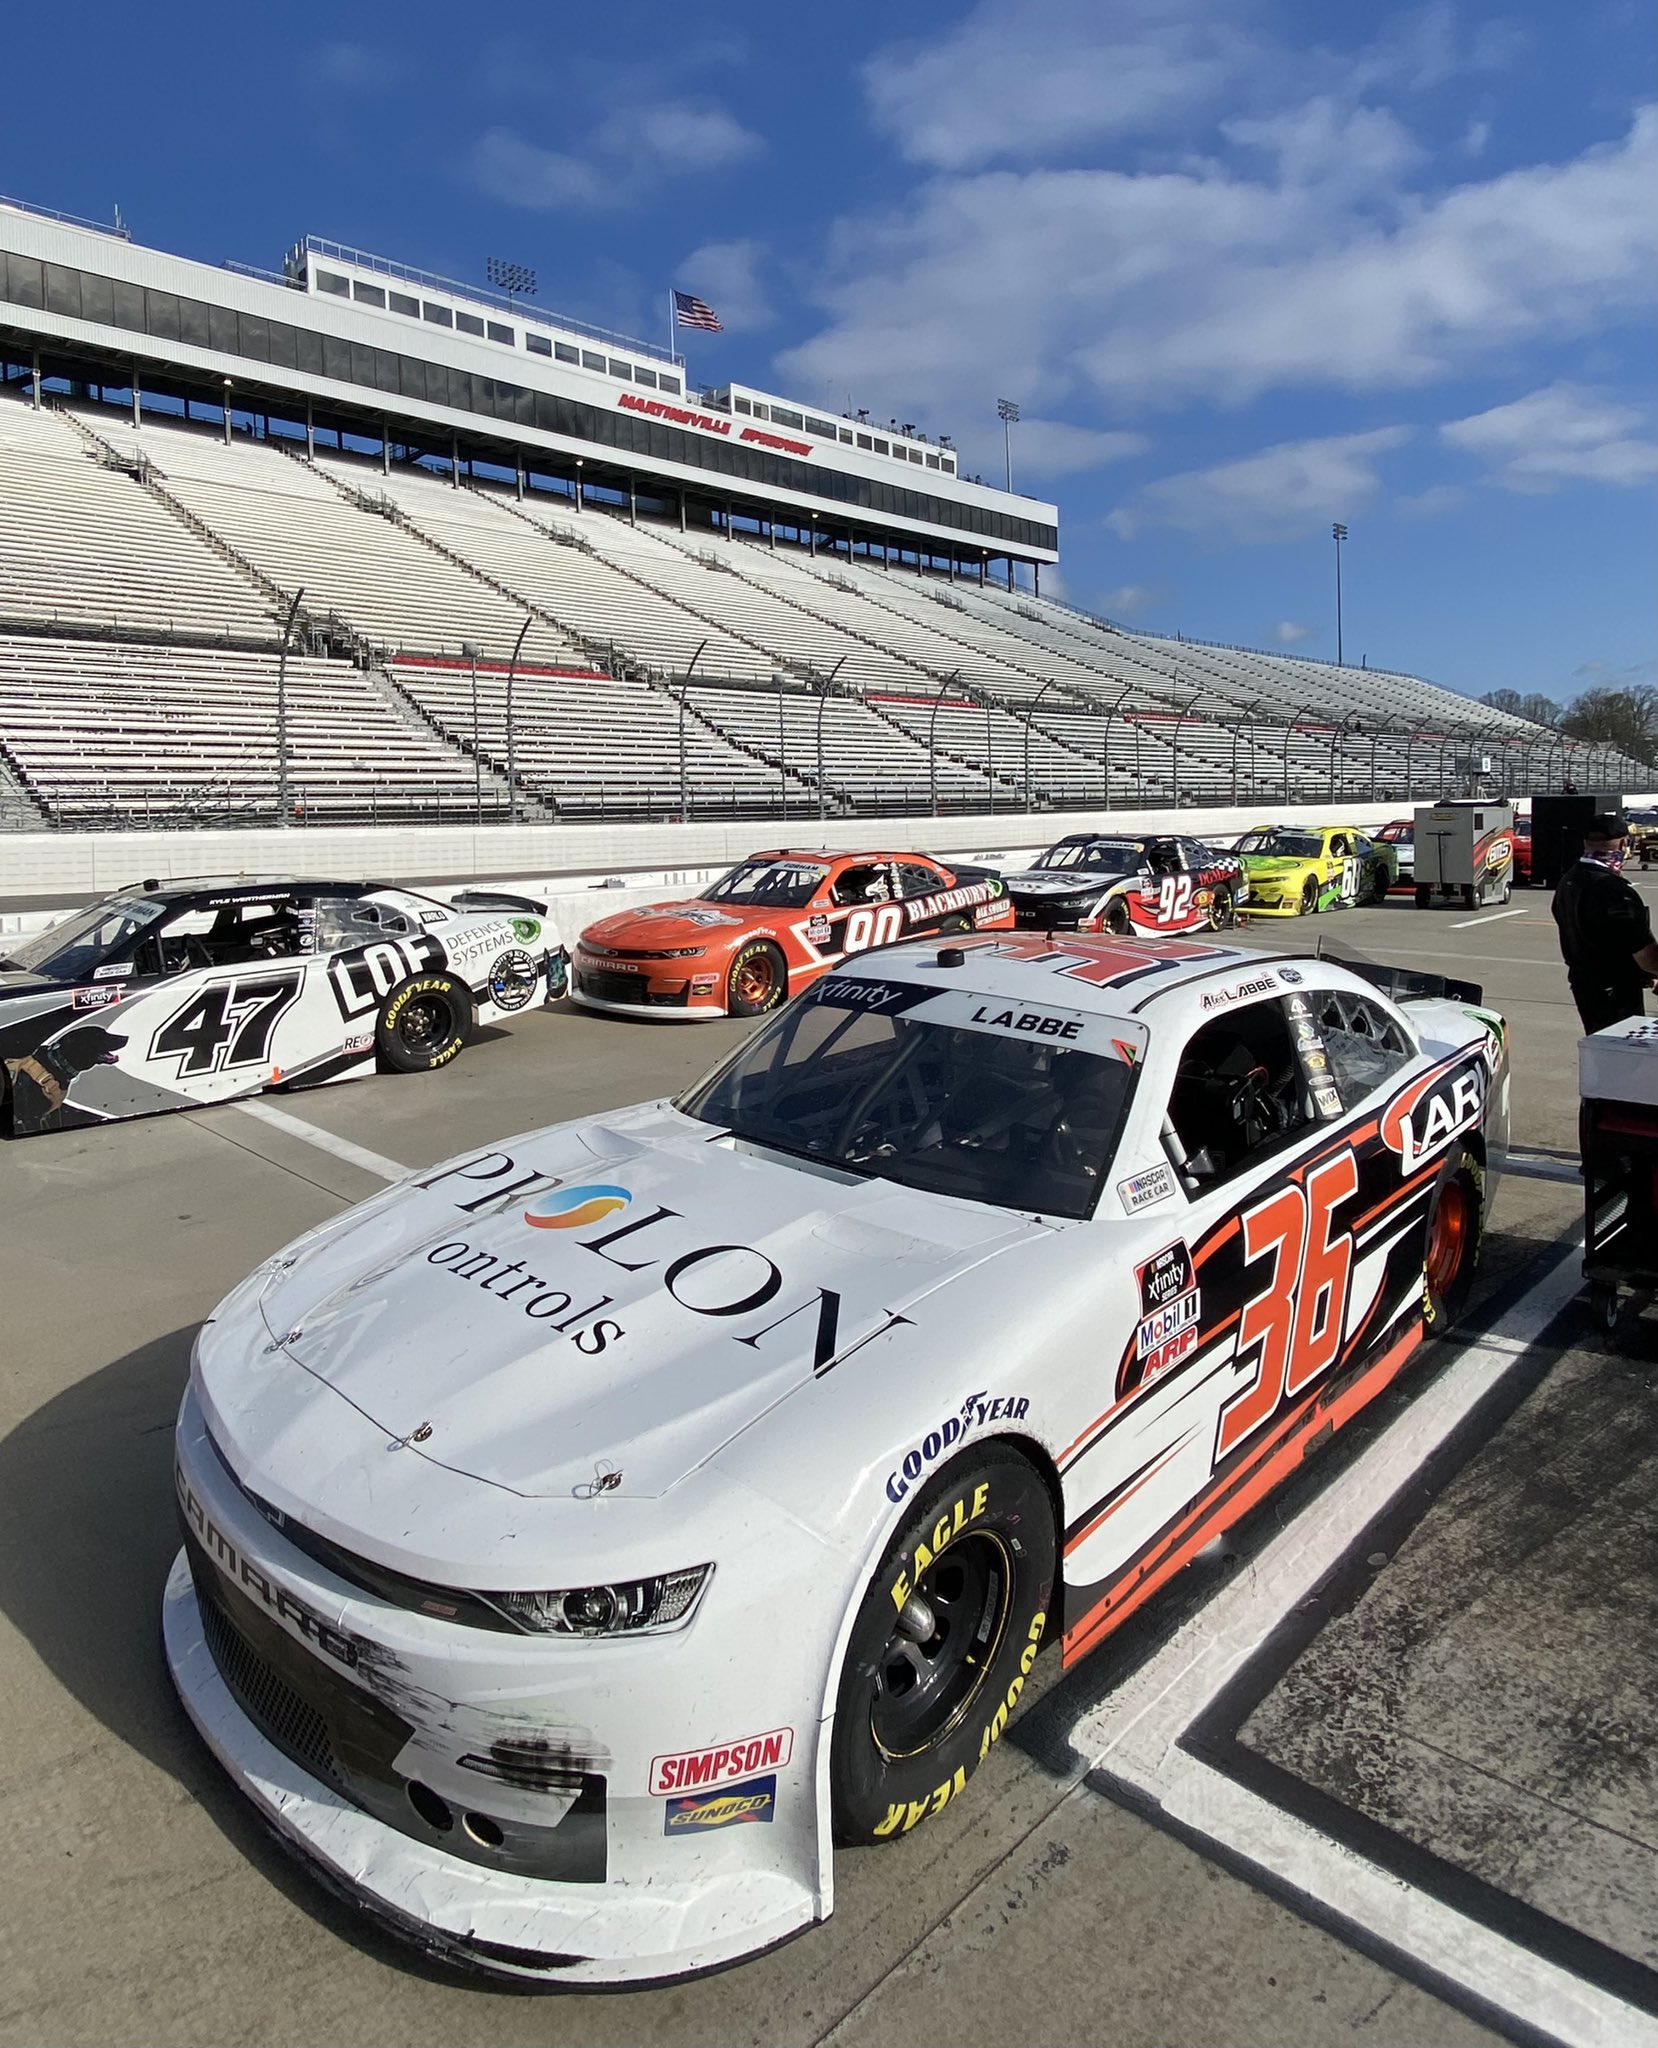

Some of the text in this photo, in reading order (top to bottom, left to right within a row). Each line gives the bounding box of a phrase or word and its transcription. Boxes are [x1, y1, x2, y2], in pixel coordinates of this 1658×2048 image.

[232, 893, 291, 902] WEATHERMAN
[1156, 874, 1192, 925] 92
[446, 920, 507, 950] DEFENCE
[452, 930, 514, 966] SYSTEMS
[581, 956, 639, 972] CAMARO
[730, 944, 768, 992] GOODYEAR
[80, 991, 113, 1005] xfinity
[385, 979, 452, 1030] GOODYEAR
[809, 979, 903, 1010] xfinity
[148, 966, 307, 1080] 47
[971, 1006, 1085, 1041] LABBE
[429, 1037, 463, 1068] EAGLE
[1131, 1182, 1170, 1206] RACE CAR
[1133, 1169, 1167, 1191] NASCAR
[1148, 1262, 1185, 1301] xfinity
[1214, 1148, 1359, 1465] 36
[1140, 1303, 1181, 1350] Mobil
[1143, 1326, 1197, 1380] ARP
[885, 1390, 1030, 1504] GOODYEAR
[176, 1460, 358, 1669] CAMARO
[889, 1481, 990, 1613] EAGLE
[658, 1734, 783, 1790] SIMPSON
[672, 1794, 770, 1826] SUNOCO
